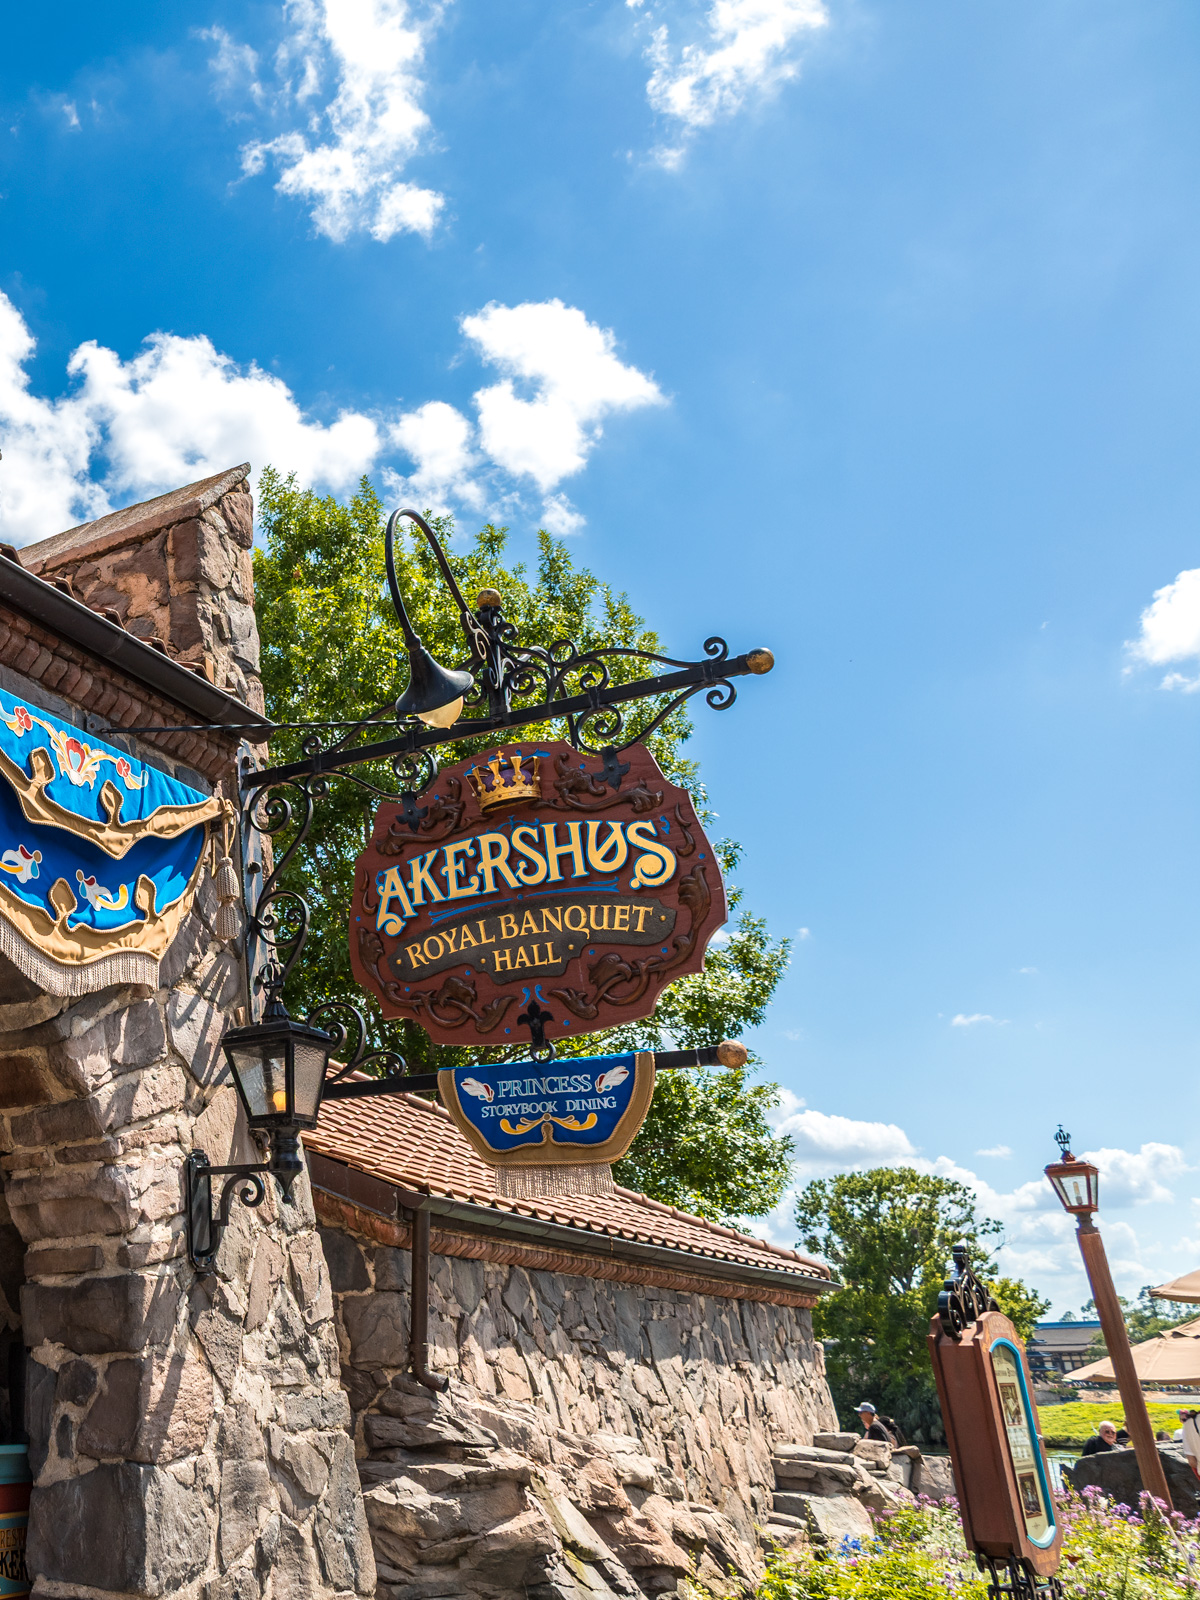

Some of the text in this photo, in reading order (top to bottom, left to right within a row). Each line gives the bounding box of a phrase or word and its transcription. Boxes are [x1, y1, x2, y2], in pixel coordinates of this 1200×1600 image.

[404, 904, 654, 969] ROYAL BANQUET
[492, 941, 562, 972] HALL
[497, 1074, 593, 1098] PRINCESS
[481, 1096, 617, 1118] STORYBOOK DINING
